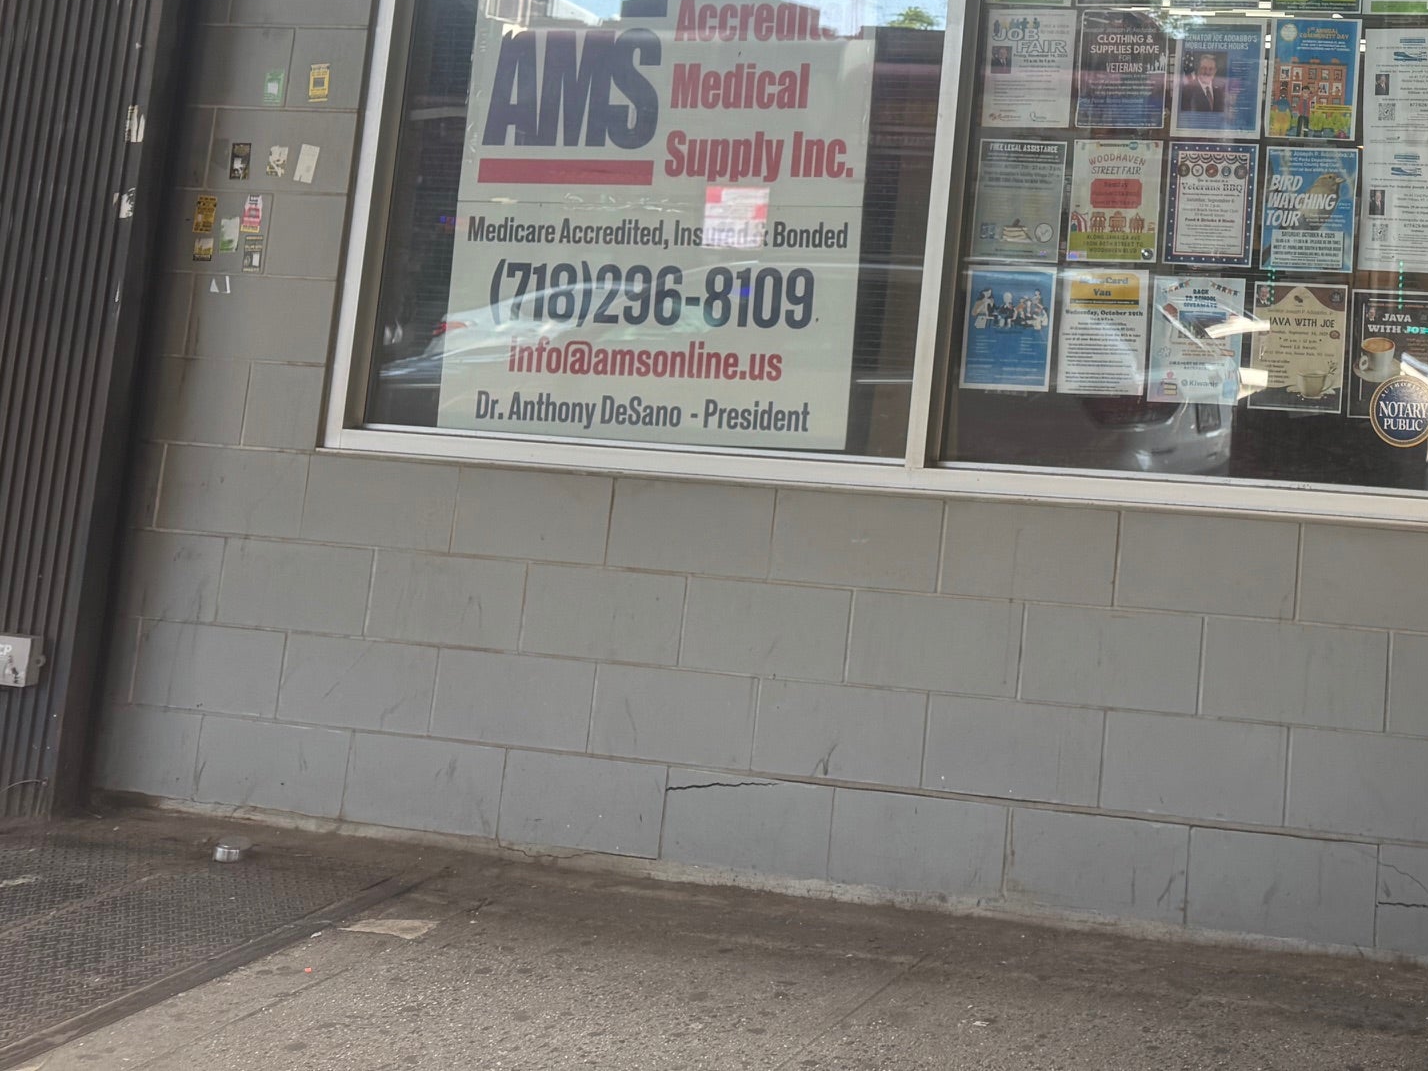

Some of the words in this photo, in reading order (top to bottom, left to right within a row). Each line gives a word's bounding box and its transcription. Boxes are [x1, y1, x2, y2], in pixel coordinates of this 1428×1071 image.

[992, 28, 1040, 42] JOB
[1097, 34, 1145, 44] CLOTHING
[1017, 39, 1068, 54] FAIR
[1090, 44, 1132, 54] SUPPLIES
[1133, 45, 1160, 54] DRIVE
[1106, 62, 1143, 73] VETERANS
[481, 27, 663, 150] AMS
[670, 62, 811, 110] Medical
[665, 130, 784, 183] Supply
[791, 132, 855, 179] Inc.
[1088, 153, 1147, 166] WOODHAVEN
[1091, 166, 1120, 175] STREET
[1121, 166, 1142, 175] FAIR
[1181, 182, 1221, 191] Veterans
[1222, 183, 1243, 194] BBQ
[1270, 174, 1303, 191] BIRD
[1266, 192, 1337, 211] WATCHING
[1265, 210, 1301, 227] TOUR
[467, 215, 556, 244] Medicare
[559, 217, 669, 251] Accredited,
[772, 221, 849, 249] Bonded
[489, 258, 815, 330] (718)296-8109
[1093, 288, 1112, 297] Van
[1100, 309, 1126, 317] October
[1382, 313, 1412, 322] JAVA
[1294, 317, 1318, 328] WITH
[1320, 319, 1336, 329] JOE
[1367, 324, 1401, 333] WITH
[508, 335, 783, 382] info@amsonline.us
[475, 391, 503, 421] Dr.
[508, 392, 596, 429] Anthony
[600, 395, 682, 427] DeSano
[703, 400, 810, 432] President
[1379, 401, 1428, 419] NOTARY
[1384, 418, 1424, 432] PUBLIC
